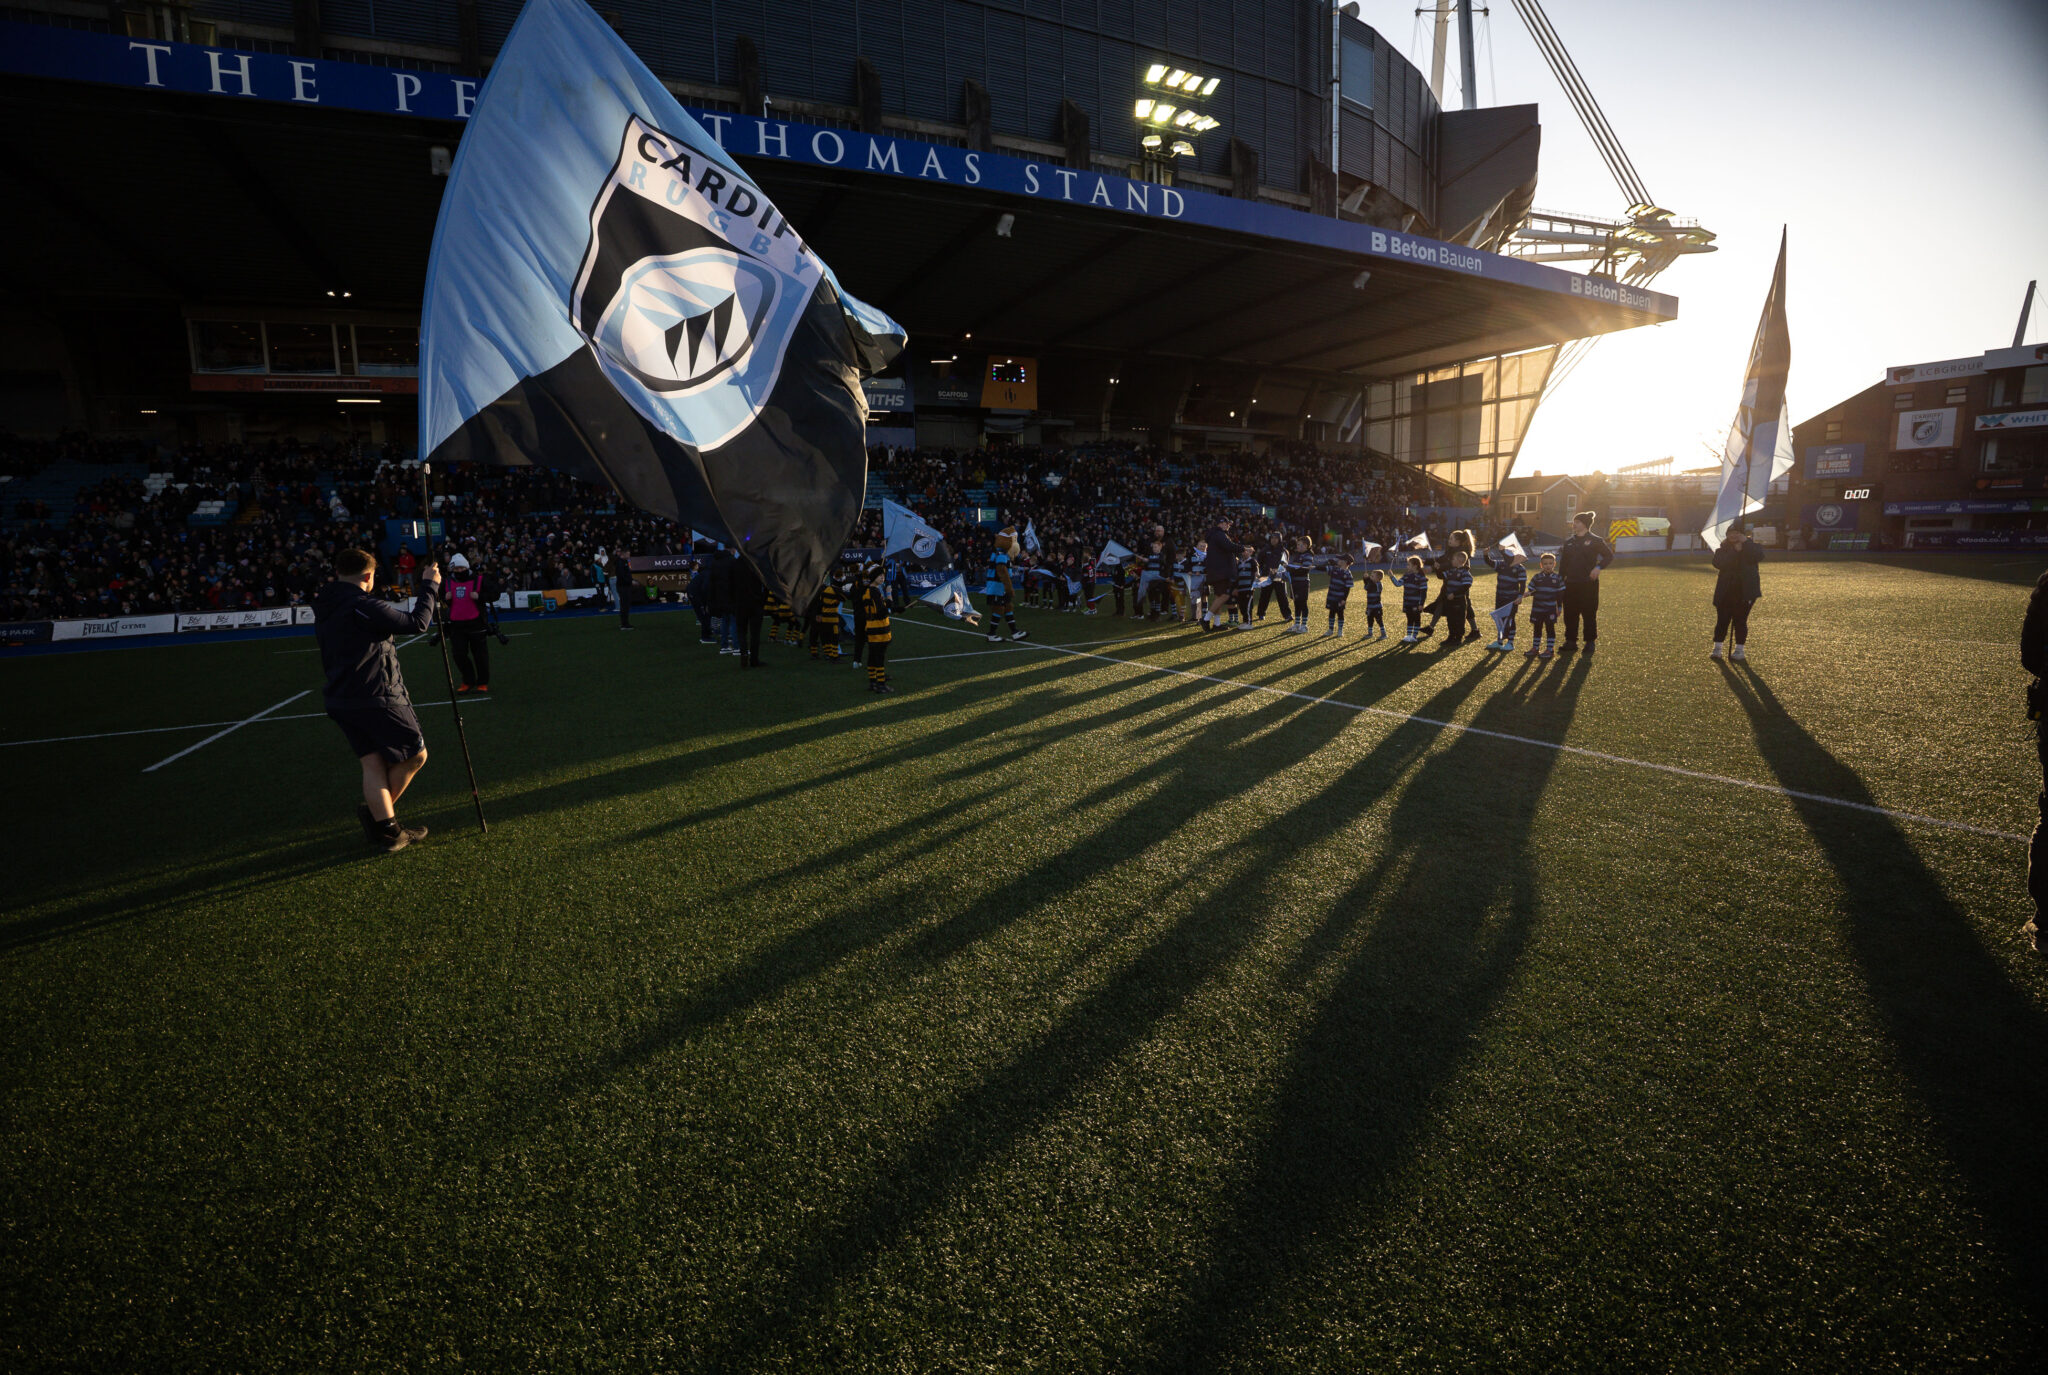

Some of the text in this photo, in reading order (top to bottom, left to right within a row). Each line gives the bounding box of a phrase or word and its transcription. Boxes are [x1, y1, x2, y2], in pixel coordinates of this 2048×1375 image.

[129, 42, 1184, 218] THE PE THOMAS STAND
[637, 132, 812, 256] CARDIF
[628, 160, 812, 276] RUGBY
[1390, 236, 1436, 262] Beton
[1440, 246, 1482, 273] Bauen
[1584, 280, 1617, 301] Beton
[1619, 288, 1652, 309] Bauen
[9, 628, 36, 636] PARK
[82, 620, 120, 636] EVERLAST
